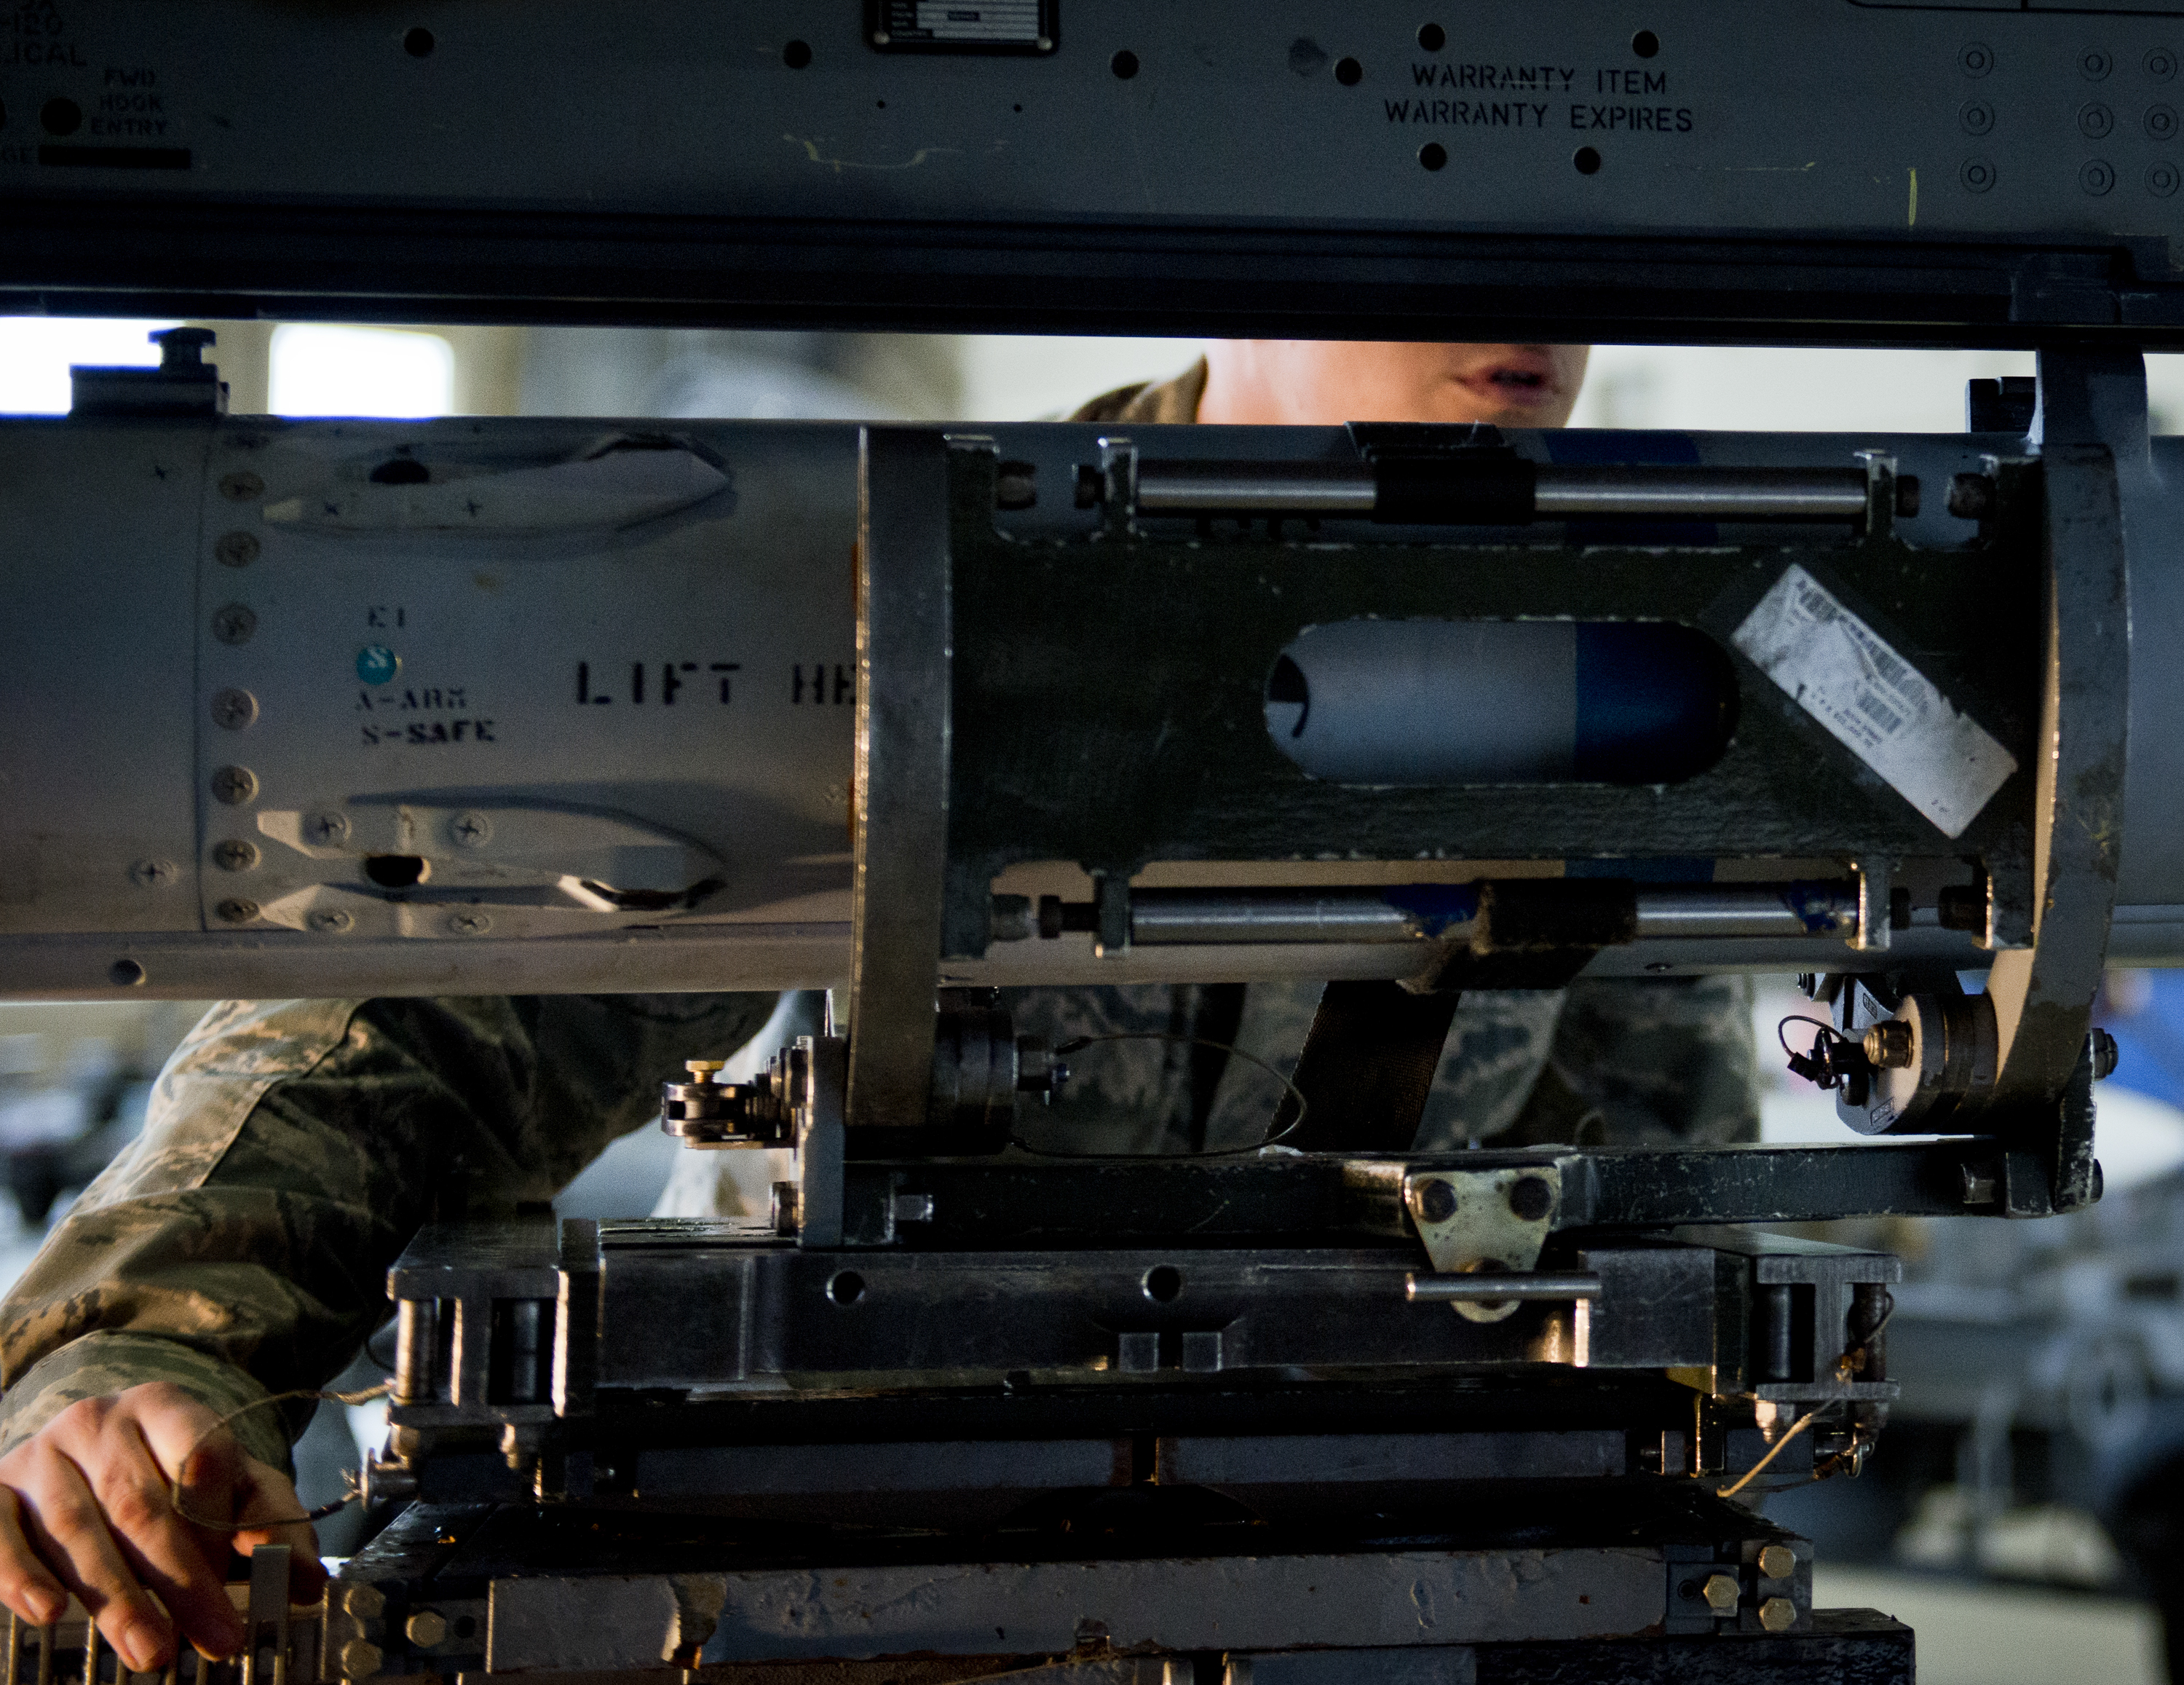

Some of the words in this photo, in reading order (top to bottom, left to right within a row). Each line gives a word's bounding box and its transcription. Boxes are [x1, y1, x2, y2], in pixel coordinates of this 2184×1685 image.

[104, 68, 156, 87] FWD
[1411, 63, 1575, 92] WARRANTY
[1597, 69, 1667, 95] ITEM
[100, 94, 162, 112] HOOK
[1384, 98, 1548, 127] WARRANTY
[1570, 104, 1694, 133] EXPIRES
[90, 117, 168, 135] ENTRY
[576, 660, 741, 705] LIFT
[361, 719, 496, 745] S-SAFE
